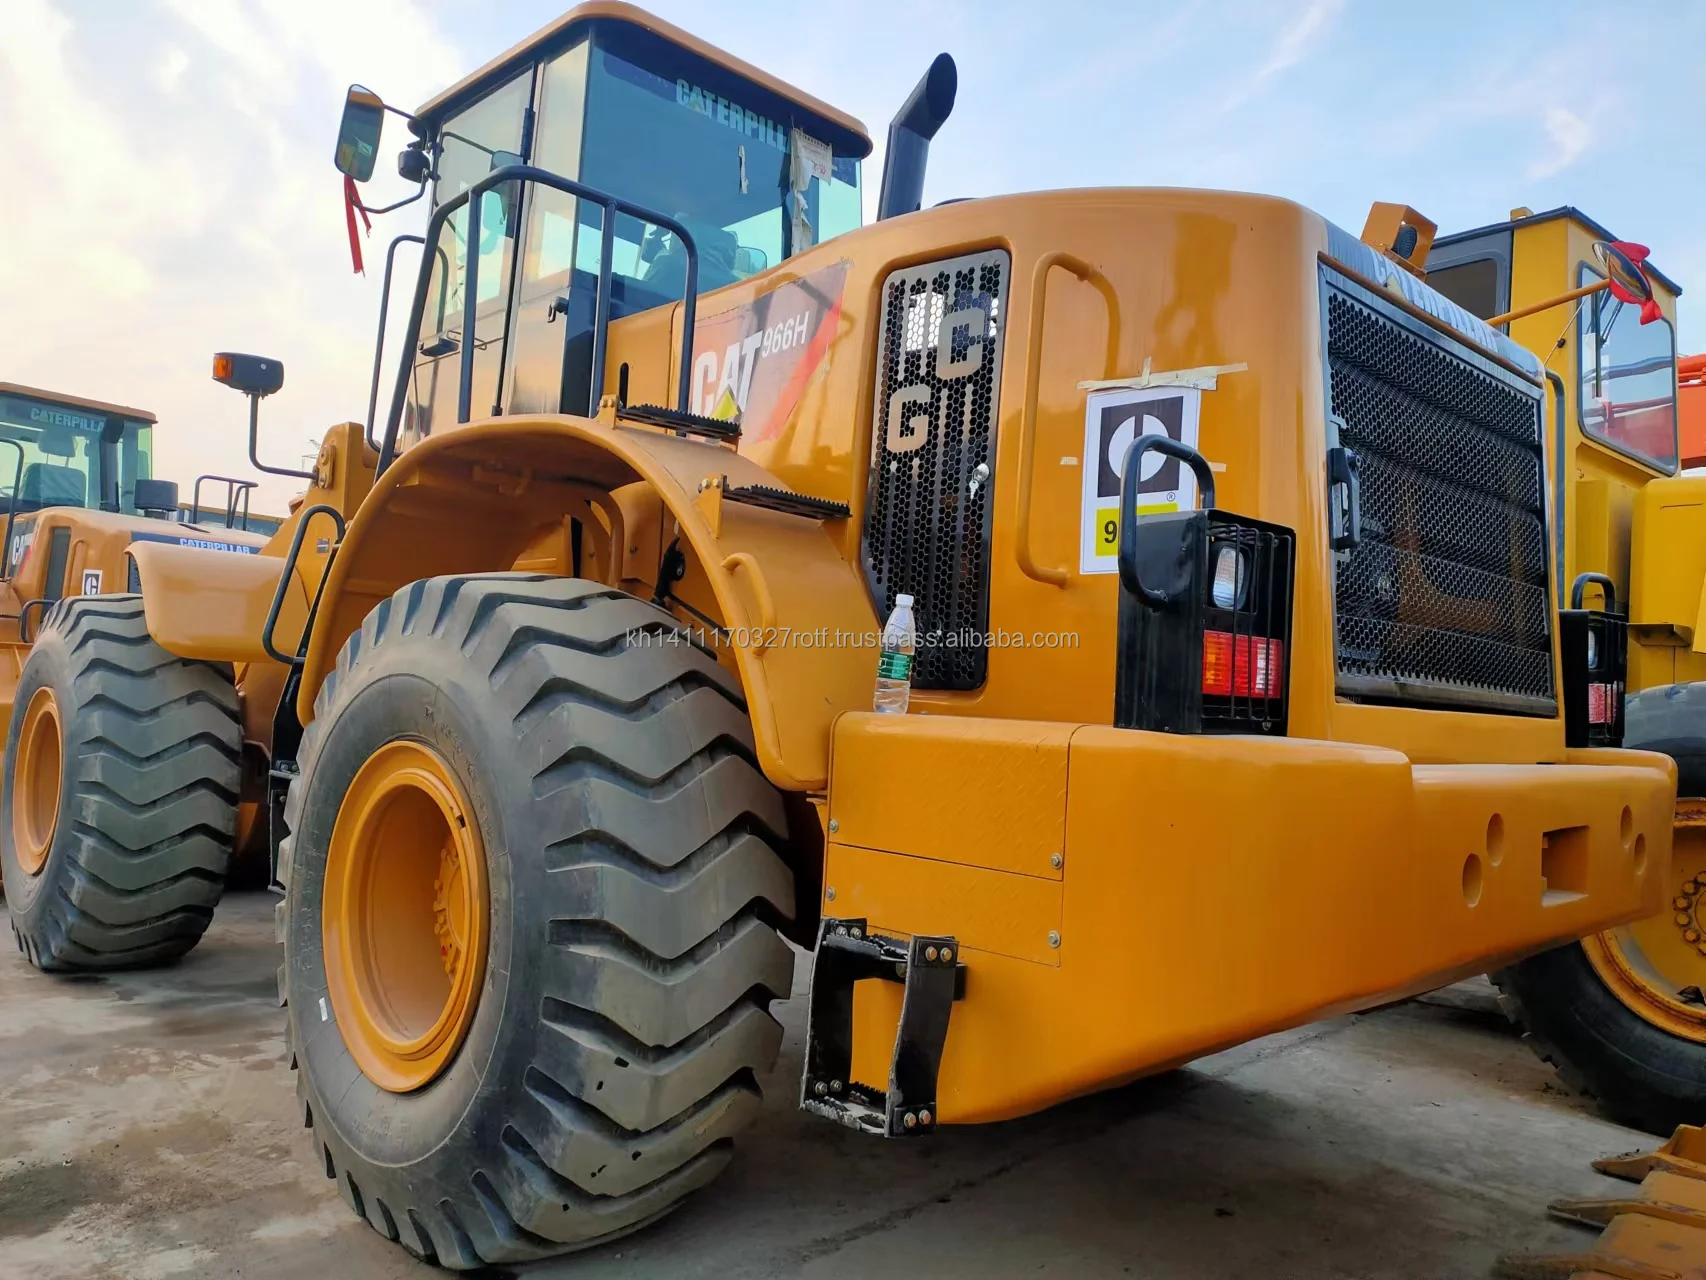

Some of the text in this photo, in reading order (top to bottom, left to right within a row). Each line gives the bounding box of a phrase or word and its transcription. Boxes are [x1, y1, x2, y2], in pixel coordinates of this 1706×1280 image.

[675, 78, 788, 153] CATERPILL
[692, 310, 810, 420] CAT 966H
[30, 407, 105, 433] CATERPILLA
